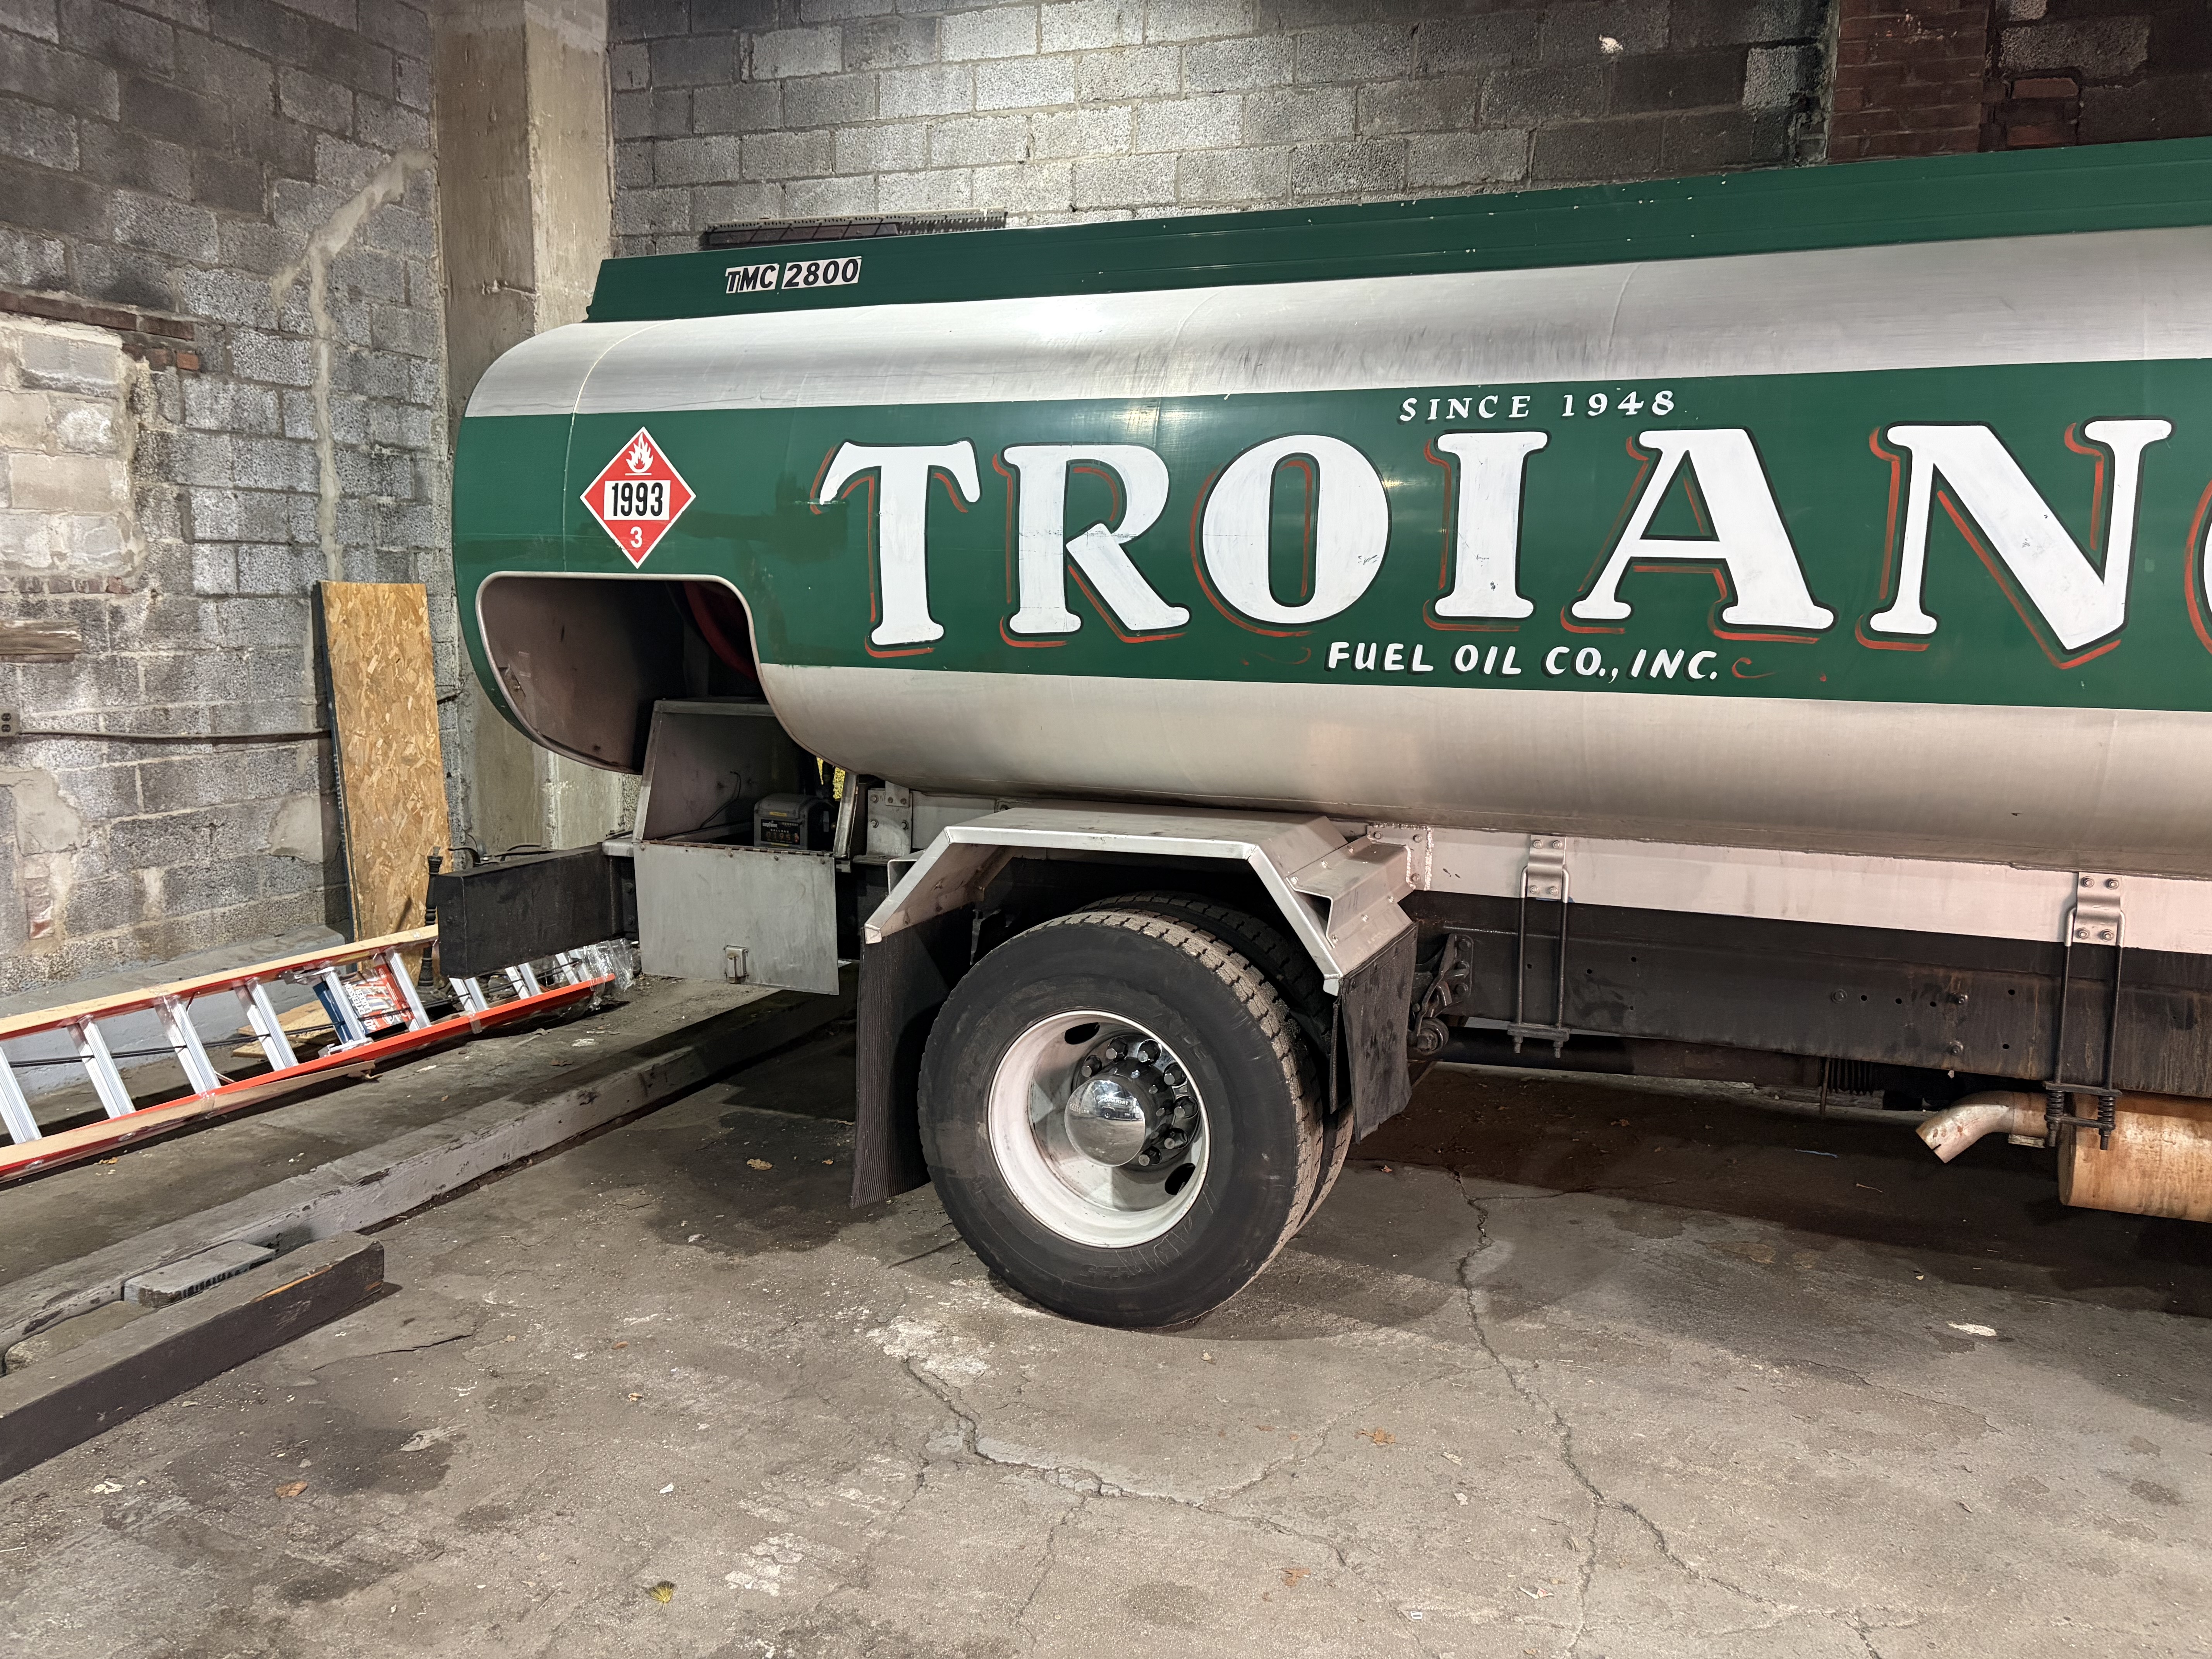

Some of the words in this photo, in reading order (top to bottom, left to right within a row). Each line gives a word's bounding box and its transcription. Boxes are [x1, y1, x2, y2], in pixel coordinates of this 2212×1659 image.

[728, 265, 776, 292] TMC
[784, 259, 858, 287] 2800
[1400, 395, 1531, 421] SINCE
[1561, 390, 1674, 417] 1948
[611, 482, 663, 517] 1993
[630, 526, 642, 548] 3
[818, 419, 2212, 650] TROIAN
[1328, 641, 1434, 673] FUEL
[1455, 644, 1522, 676] OIL
[1631, 649, 1717, 680] INC.
[343, 981, 366, 1015] EXTENSION
[355, 988, 373, 1013] LADDER
